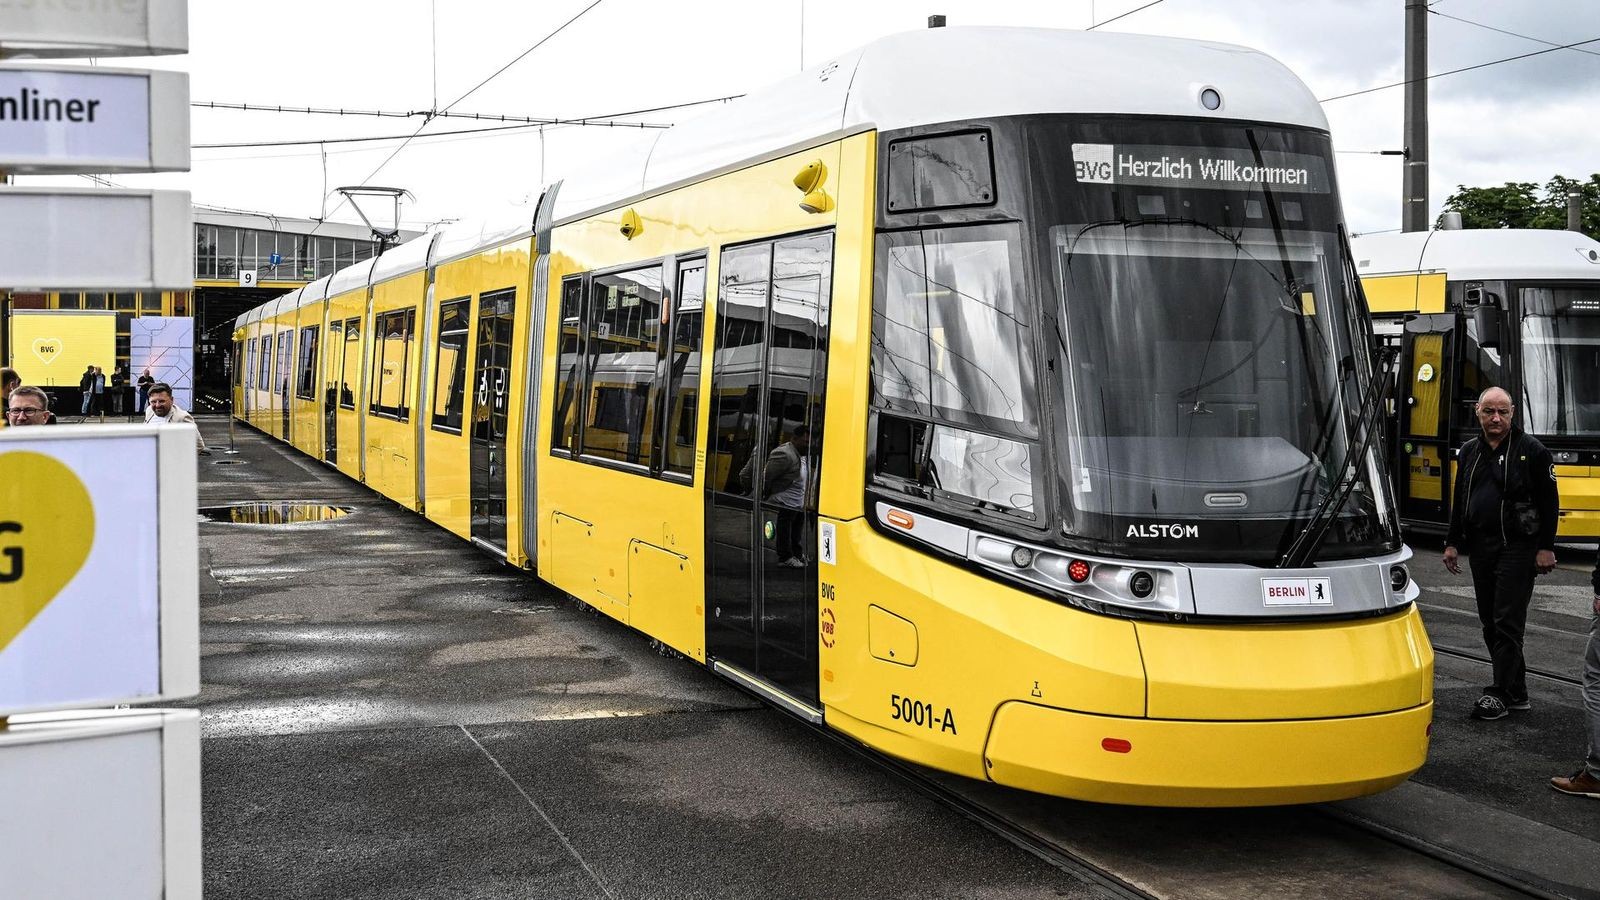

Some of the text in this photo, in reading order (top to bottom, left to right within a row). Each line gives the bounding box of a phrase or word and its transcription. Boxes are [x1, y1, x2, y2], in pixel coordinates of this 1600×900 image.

[0, 87, 100, 122] nliner
[1074, 154, 1308, 185] BVG Herzlich Willkommen
[244, 273, 251, 283] 9
[1126, 523, 1199, 539] ALSTOM
[821, 582, 835, 601] BVG
[1268, 586, 1305, 598] BERLIN
[821, 620, 834, 635] VBB
[891, 694, 957, 735] 5001-A
